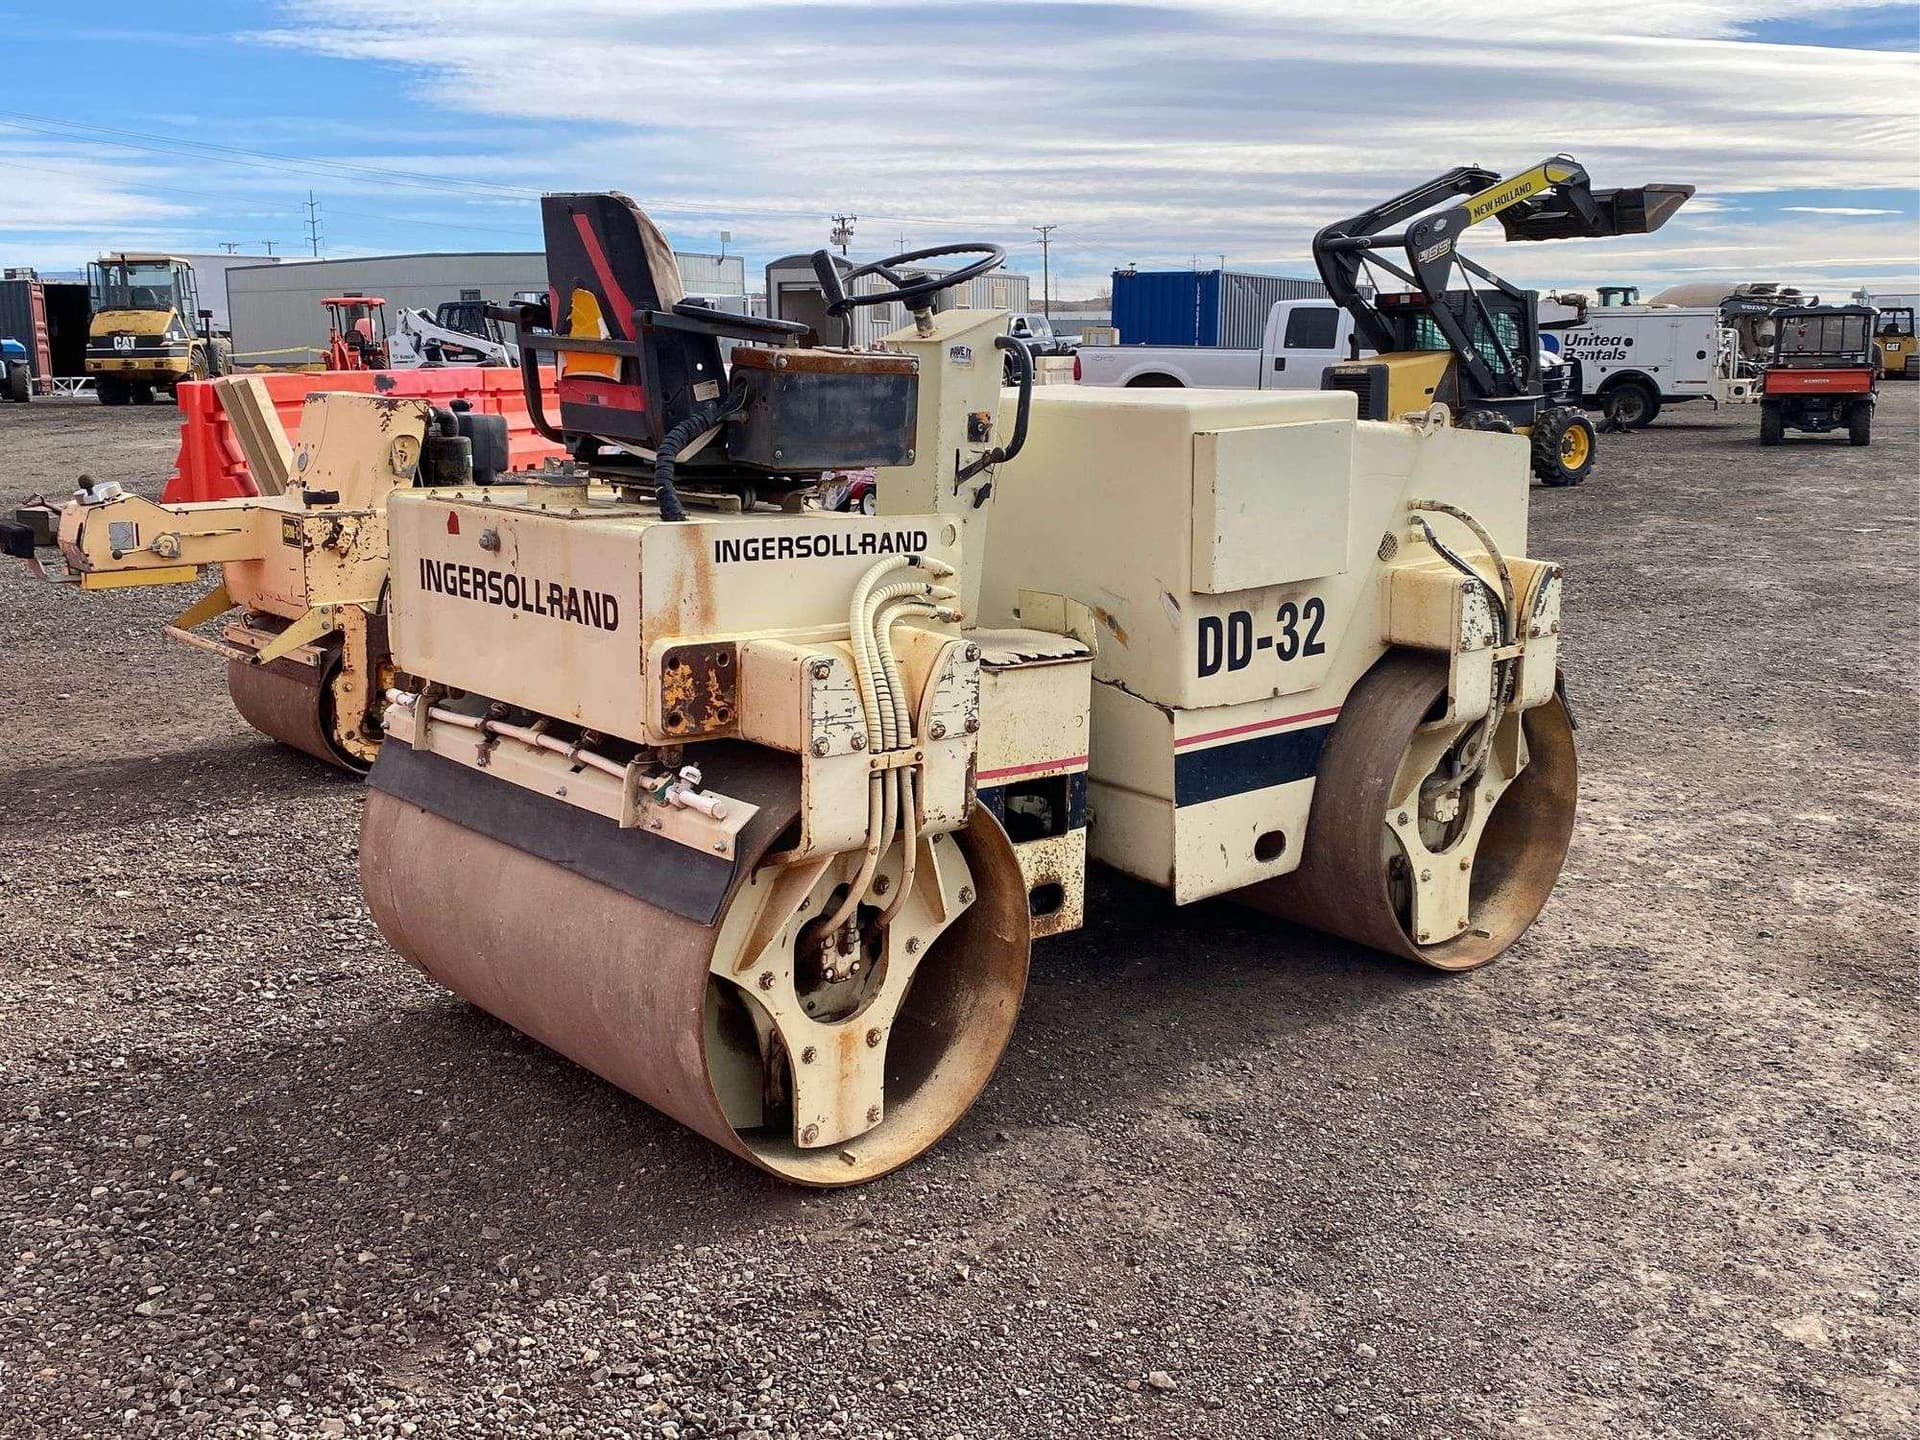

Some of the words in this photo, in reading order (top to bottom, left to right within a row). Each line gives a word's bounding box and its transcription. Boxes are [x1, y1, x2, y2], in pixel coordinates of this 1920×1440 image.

[1473, 201, 1494, 218] NEW
[1493, 182, 1532, 207] HOLLAND
[113, 336, 136, 350] CAT
[1198, 597, 1326, 678] DD-32
